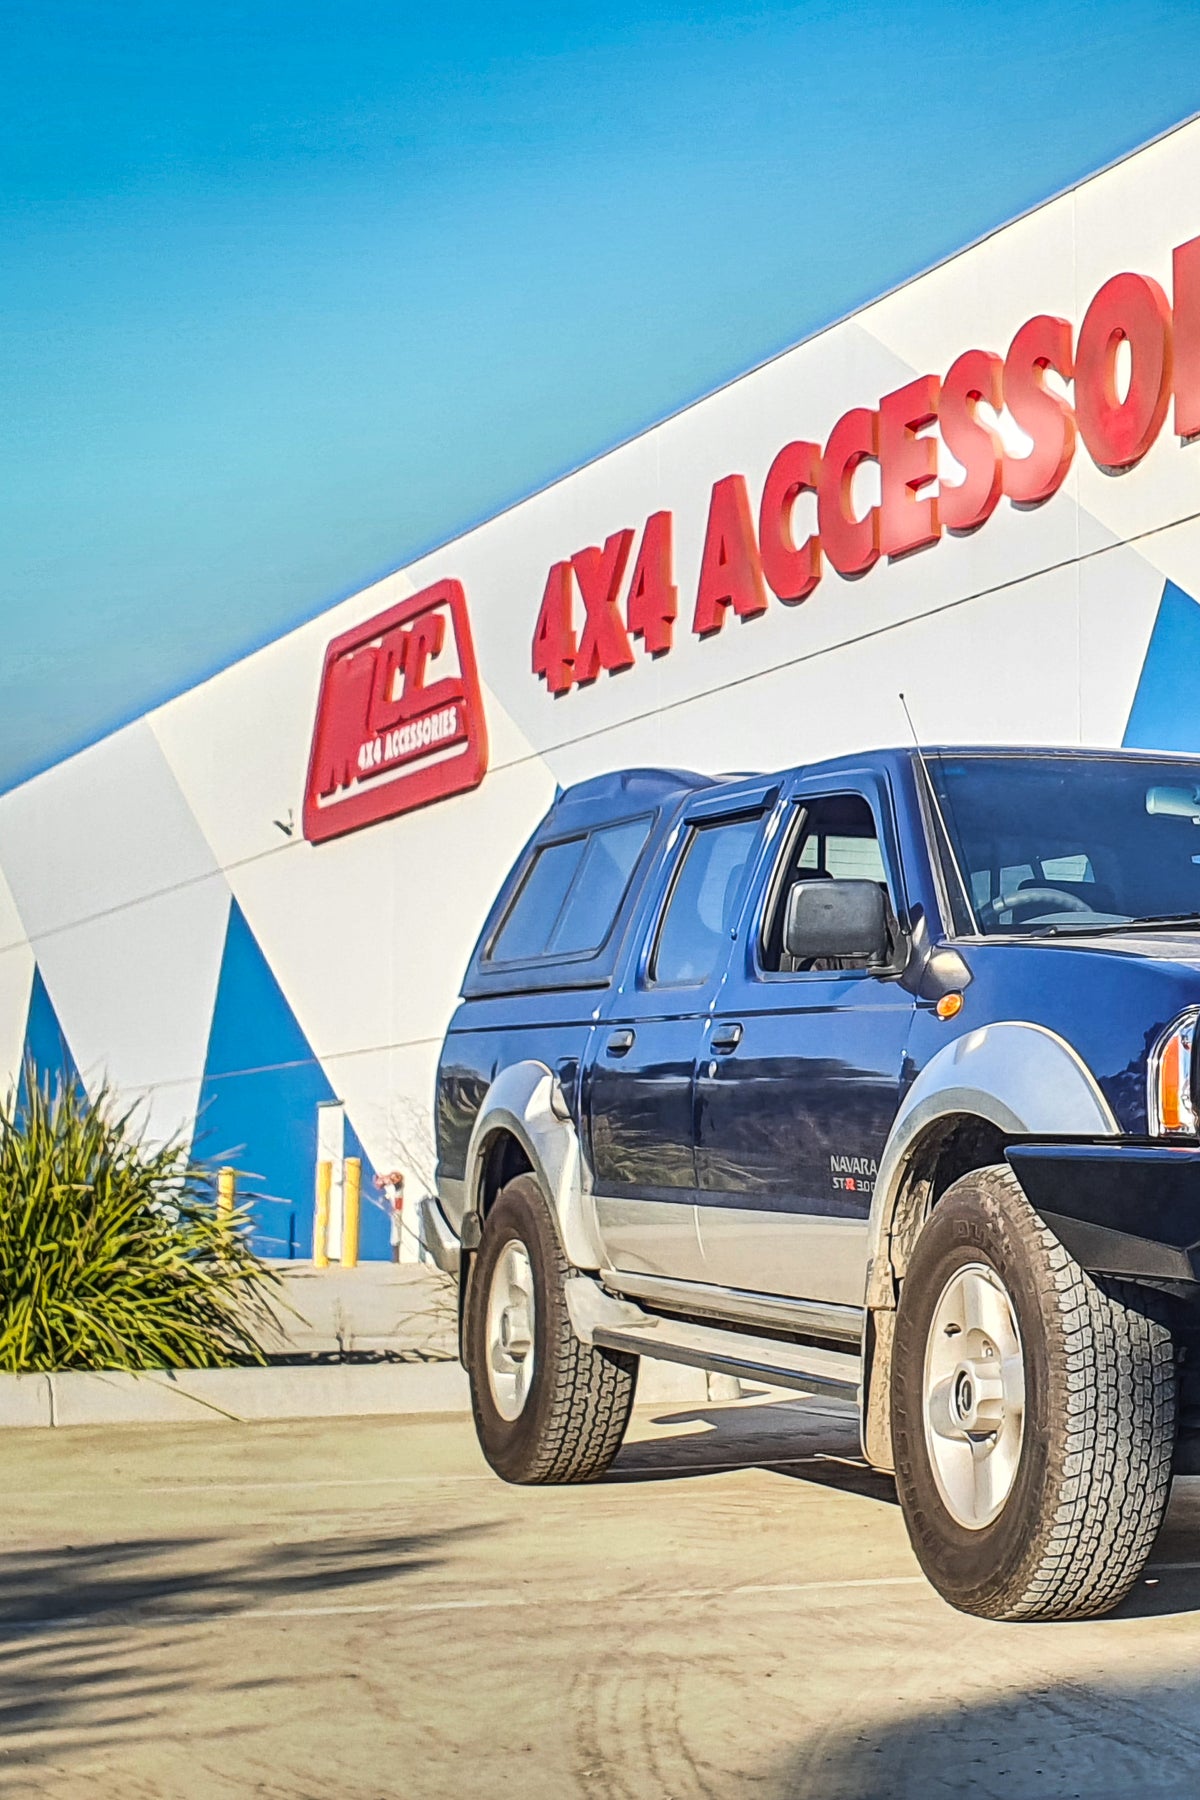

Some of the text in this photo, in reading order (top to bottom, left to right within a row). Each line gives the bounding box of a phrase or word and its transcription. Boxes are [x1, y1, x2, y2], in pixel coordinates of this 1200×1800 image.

[532, 510, 677, 693] 4X4
[358, 706, 457, 771] 4X4 ACCESSORIES
[830, 1155, 878, 1175] NAVARA
